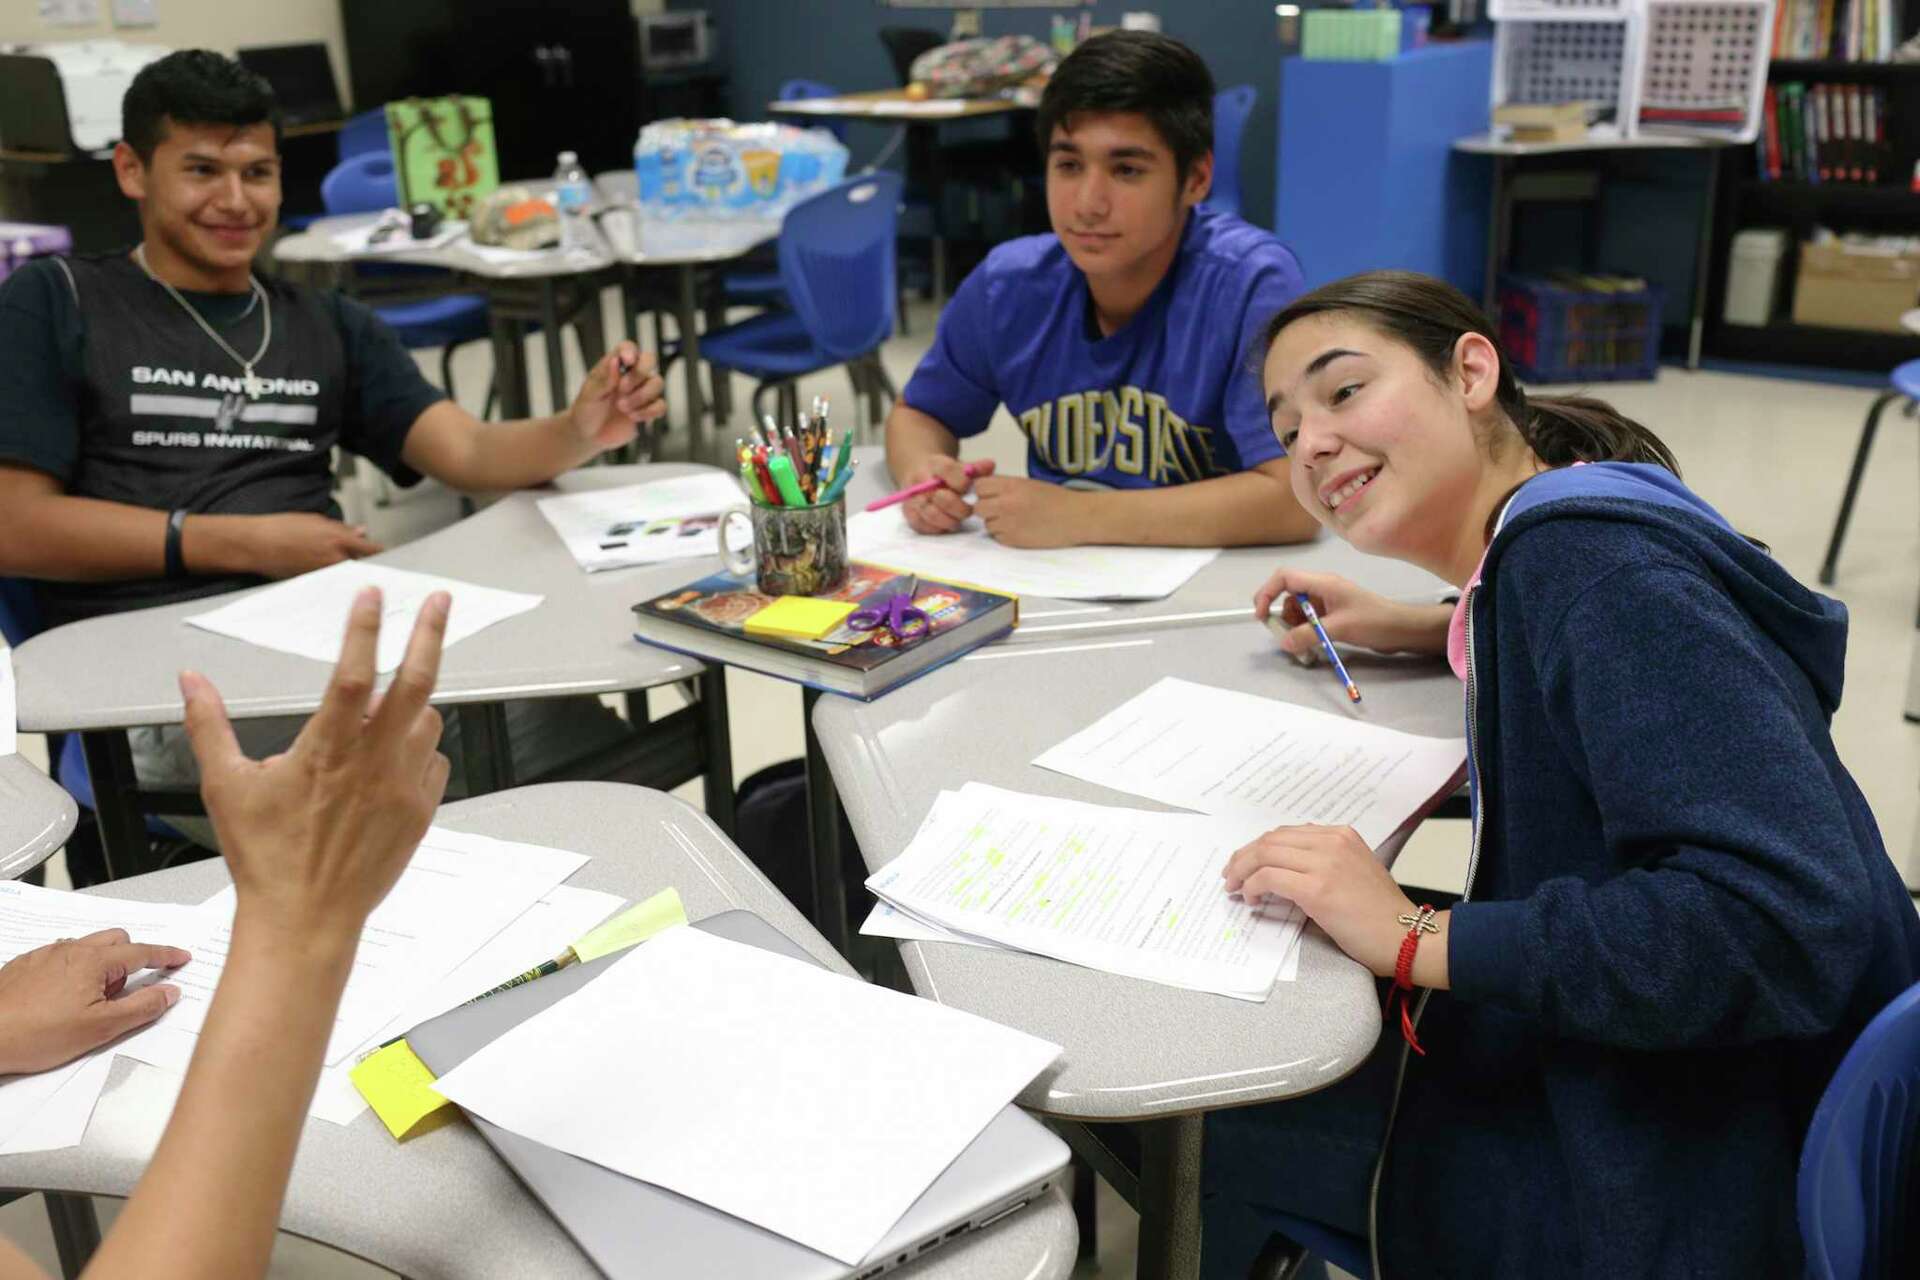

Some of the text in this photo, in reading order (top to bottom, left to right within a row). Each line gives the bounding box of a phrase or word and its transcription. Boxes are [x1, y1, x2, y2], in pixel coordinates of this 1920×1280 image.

[131, 365, 196, 387] SAN
[132, 430, 201, 448] SPURS
[1114, 385, 1231, 484] STATE
